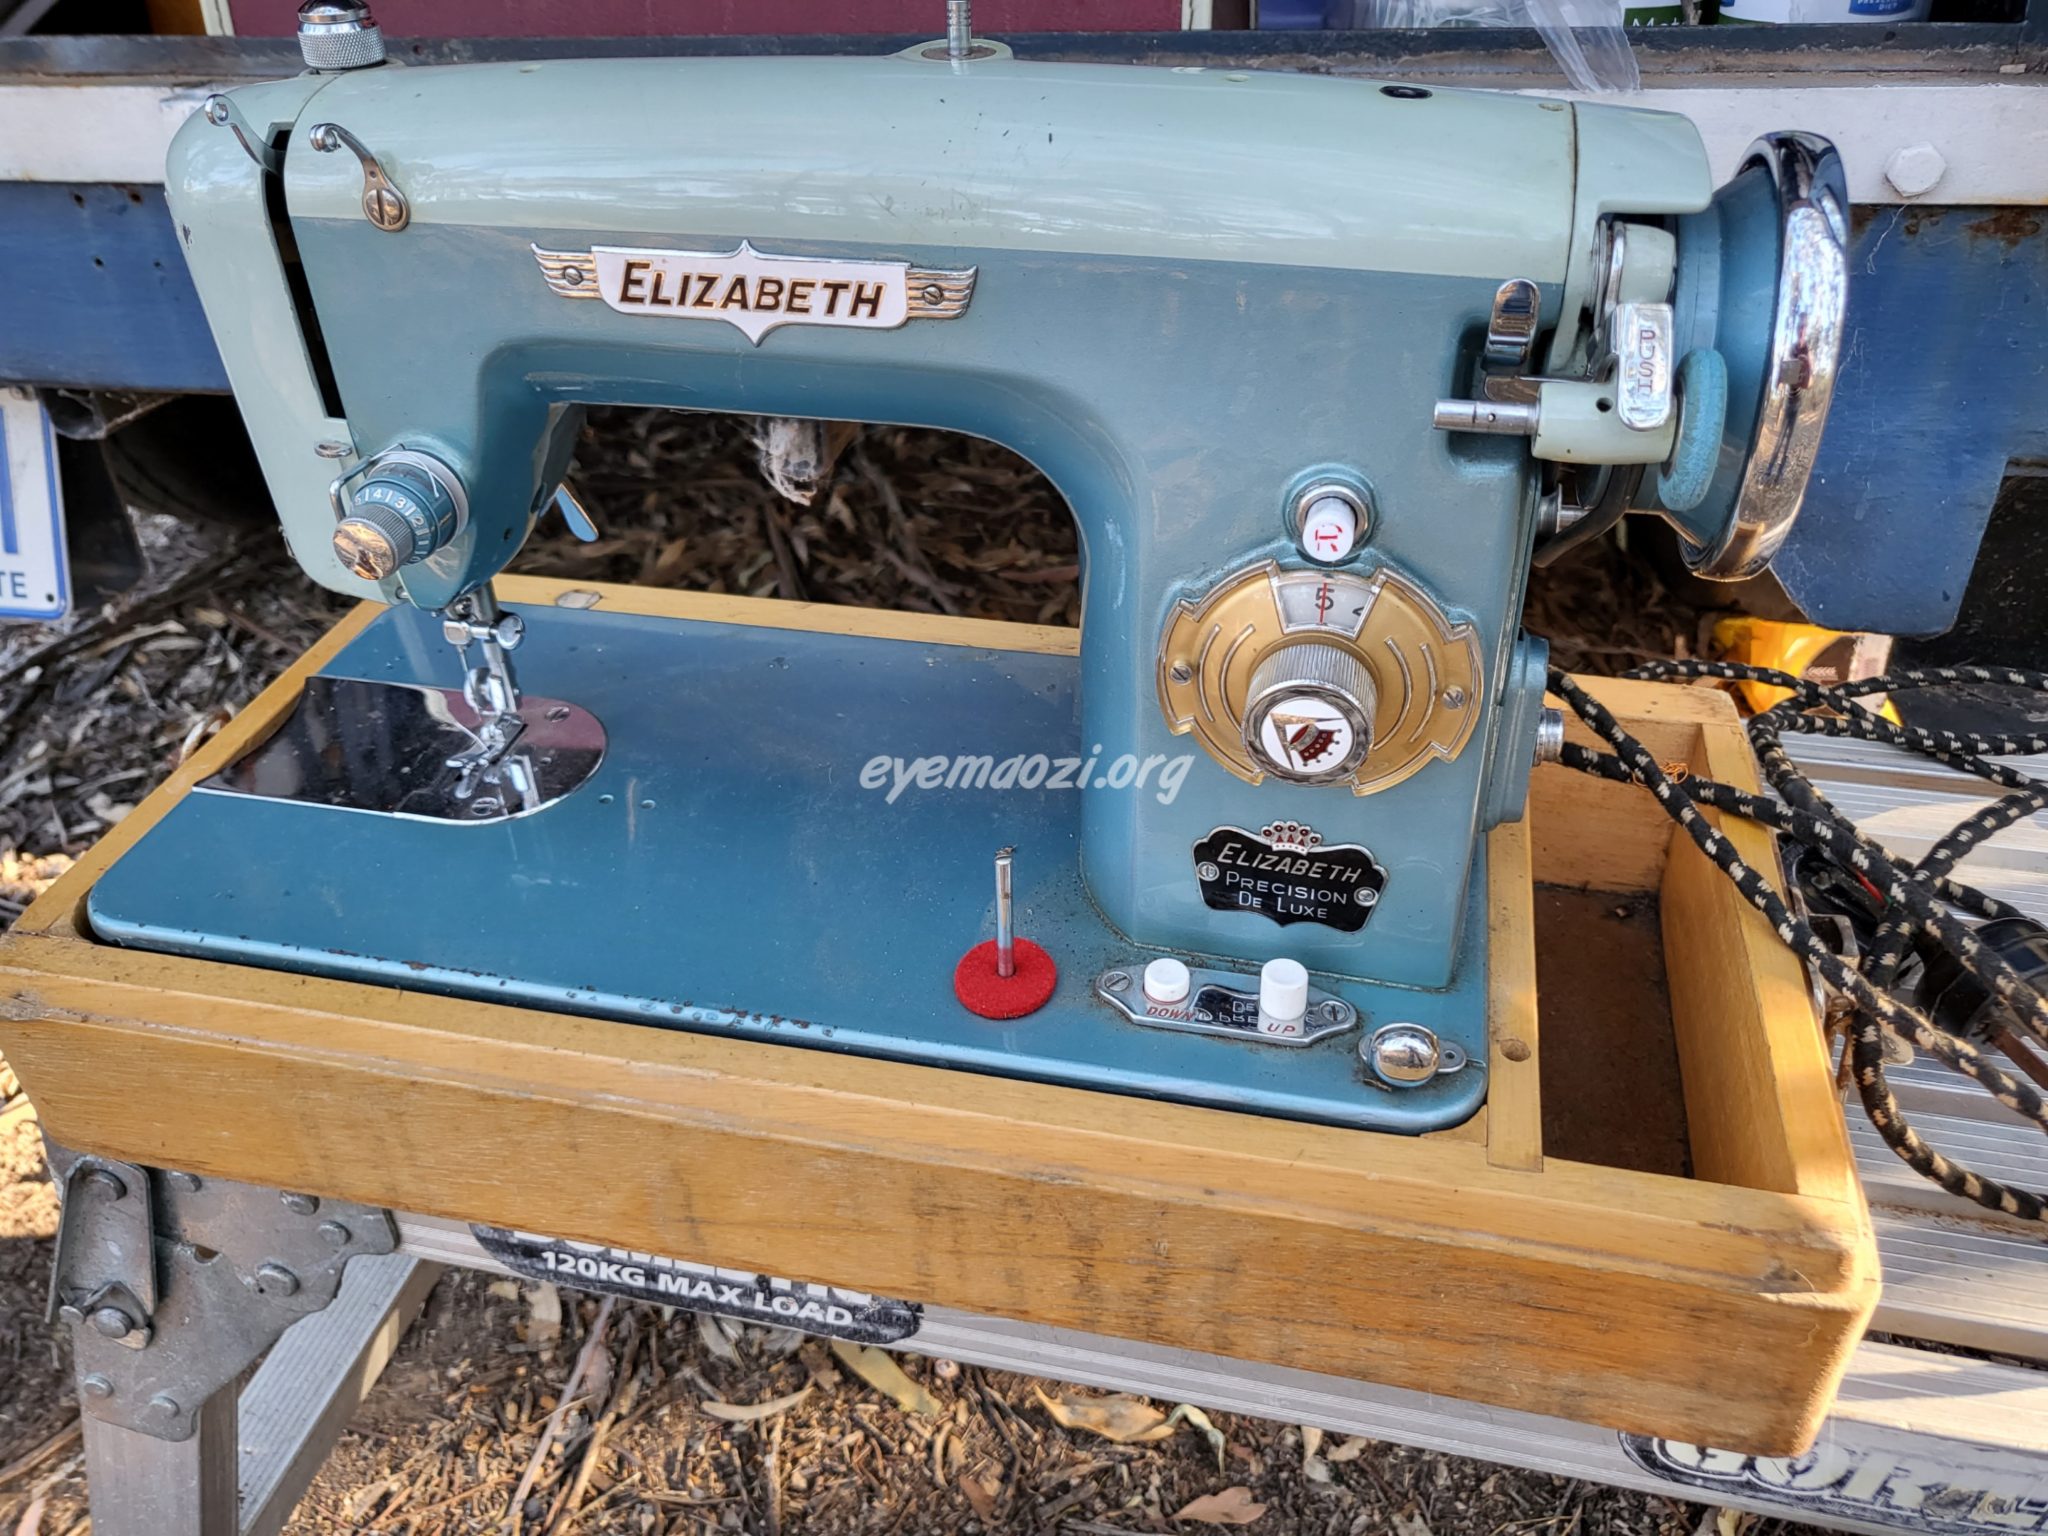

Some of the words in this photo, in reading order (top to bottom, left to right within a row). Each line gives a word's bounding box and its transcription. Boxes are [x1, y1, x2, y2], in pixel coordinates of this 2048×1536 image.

[619, 259, 887, 319] ELIZABETH
[1638, 329, 1656, 393] PUSH
[373, 489, 383, 499] 4
[395, 497, 407, 509] 3
[412, 516, 424, 527] 2
[1315, 587, 1335, 611] 5
[1217, 842, 1362, 884] ELIZABETH
[1226, 871, 1348, 905] PRECISION
[1277, 896, 1329, 920] LUXE
[1146, 1005, 1195, 1022] DOWN
[1267, 1023, 1296, 1034] UP
[541, 1251, 646, 1287] 120KG
[657, 1273, 744, 1306] MAX
[755, 1291, 853, 1327] LOAD
